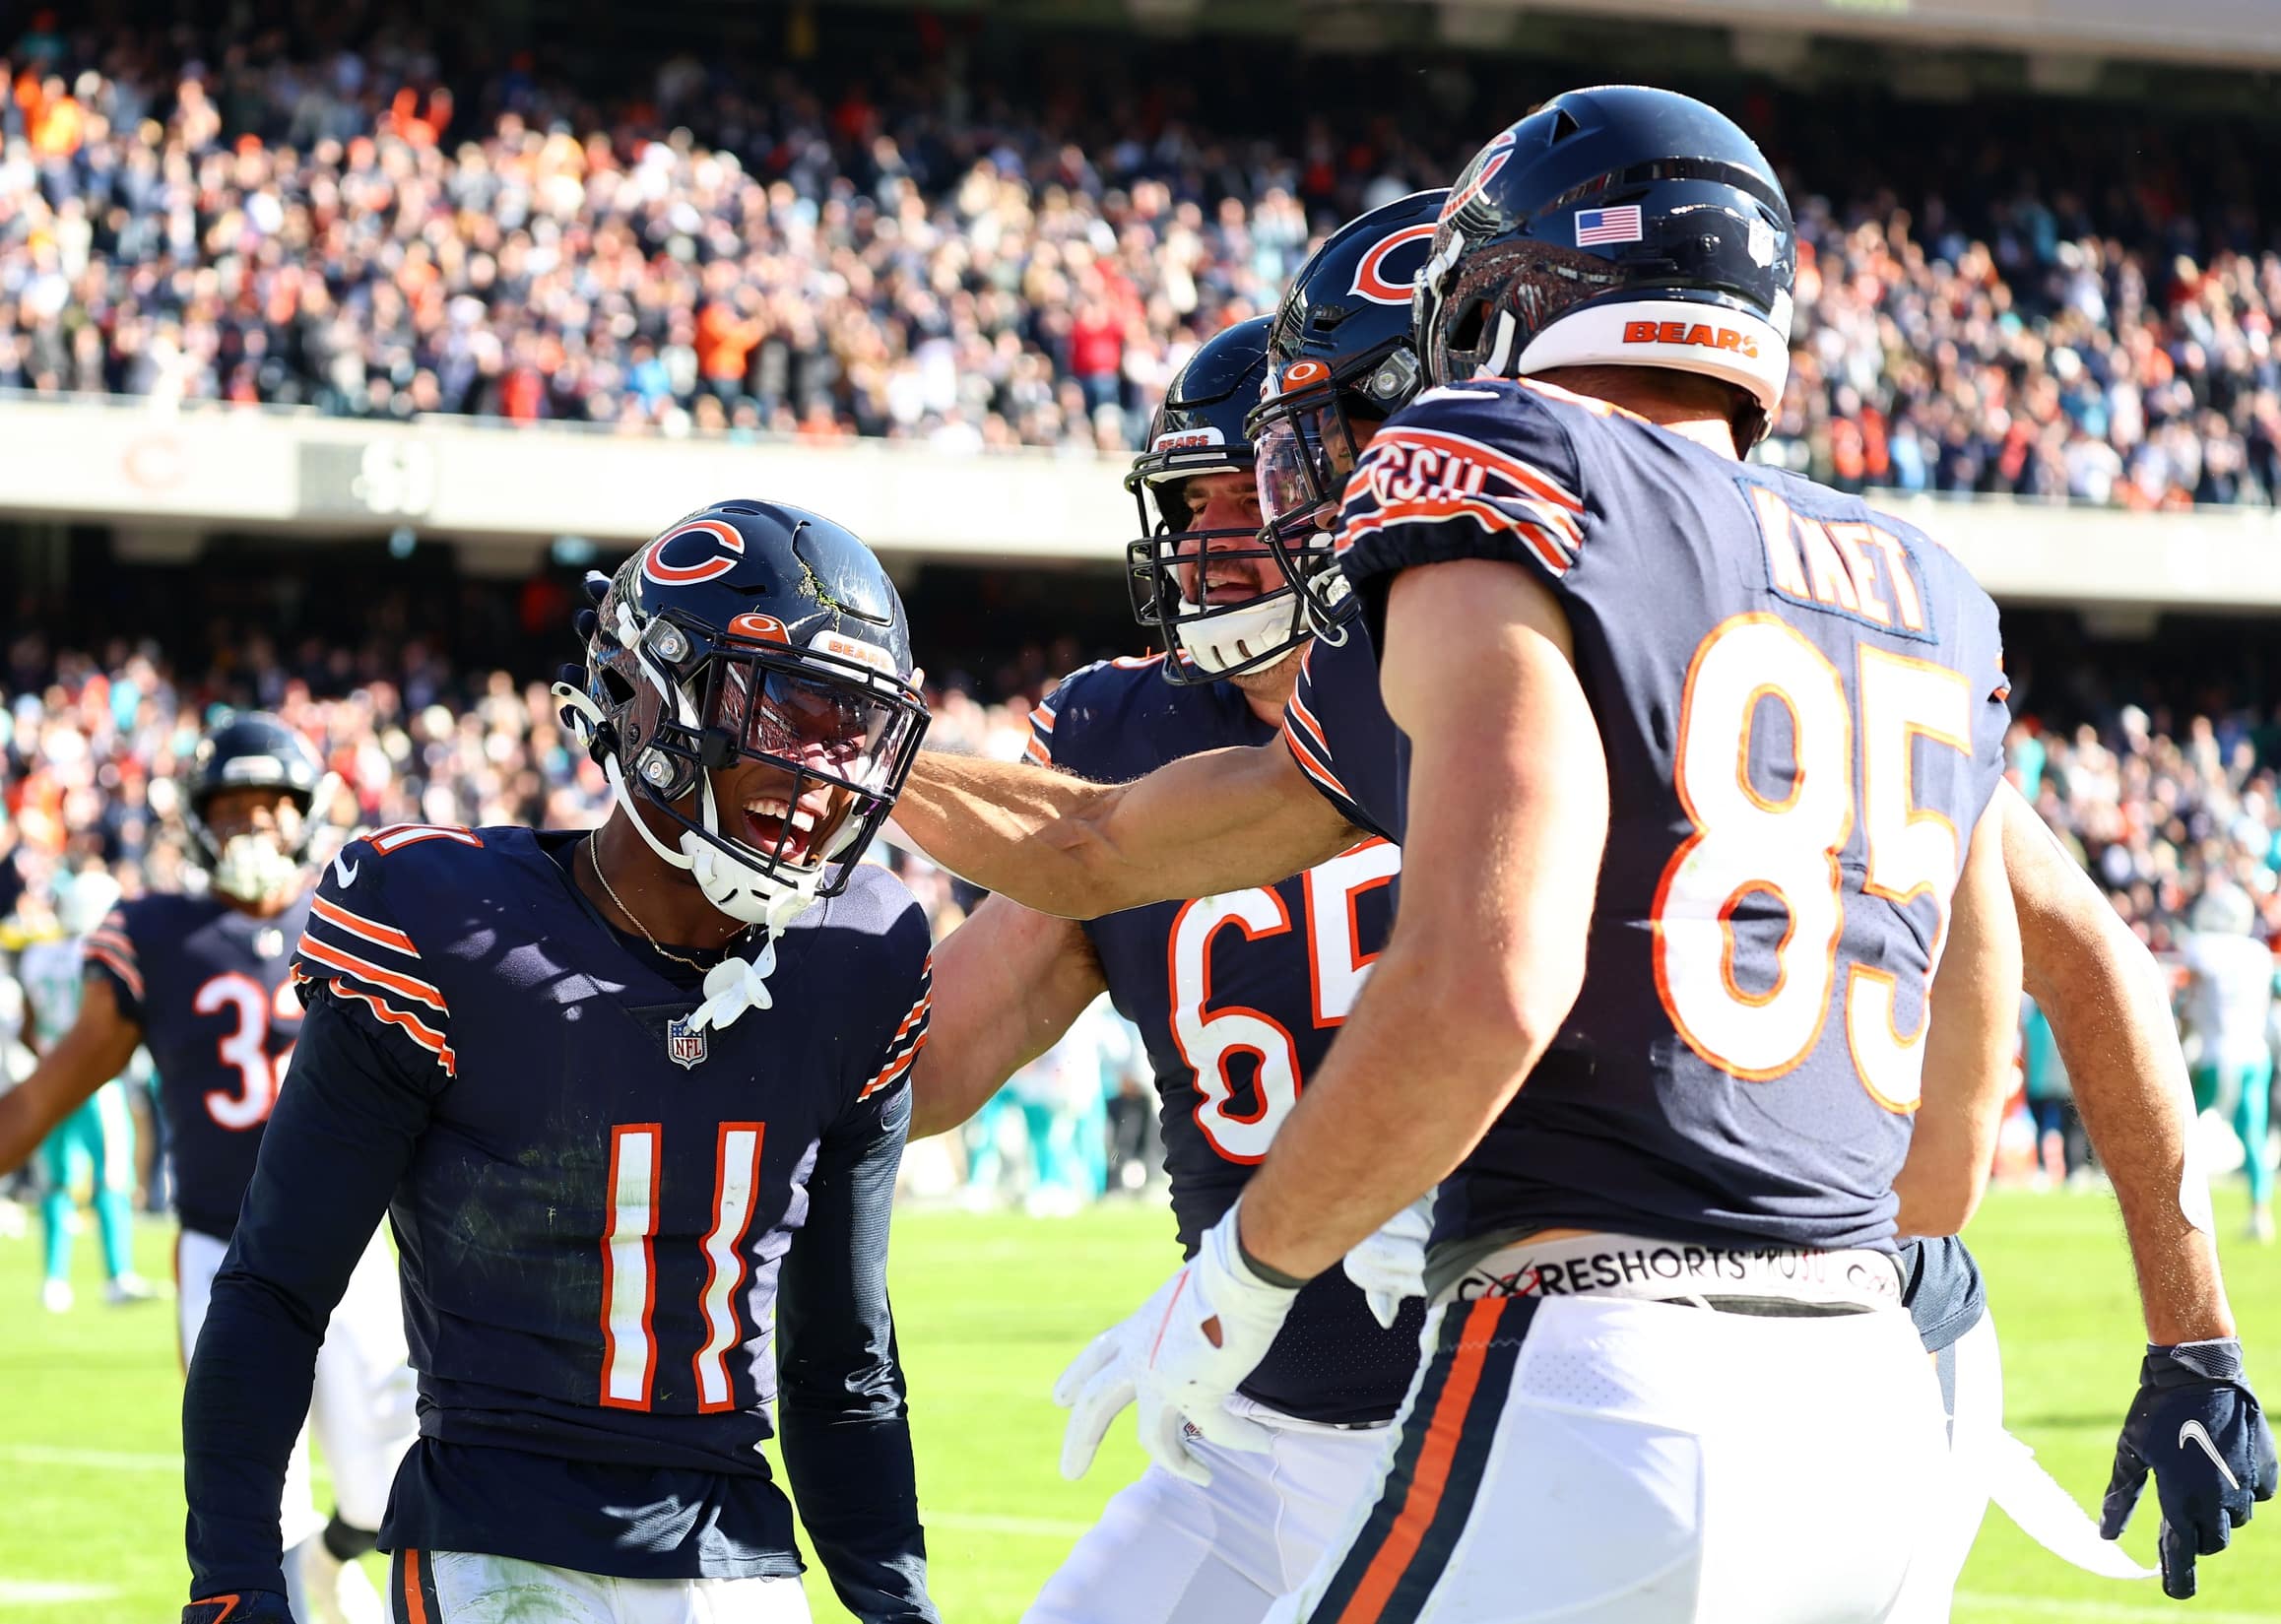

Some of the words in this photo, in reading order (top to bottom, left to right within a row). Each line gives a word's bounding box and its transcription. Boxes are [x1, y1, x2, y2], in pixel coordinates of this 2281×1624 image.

[1623, 321, 1758, 358] BEARS
[1157, 434, 1209, 451] BEARS
[641, 519, 746, 586] C
[828, 639, 889, 670] BEARS
[1651, 610, 1974, 1115] 85
[675, 1038, 702, 1059] NFL
[599, 1121, 765, 1414] 11
